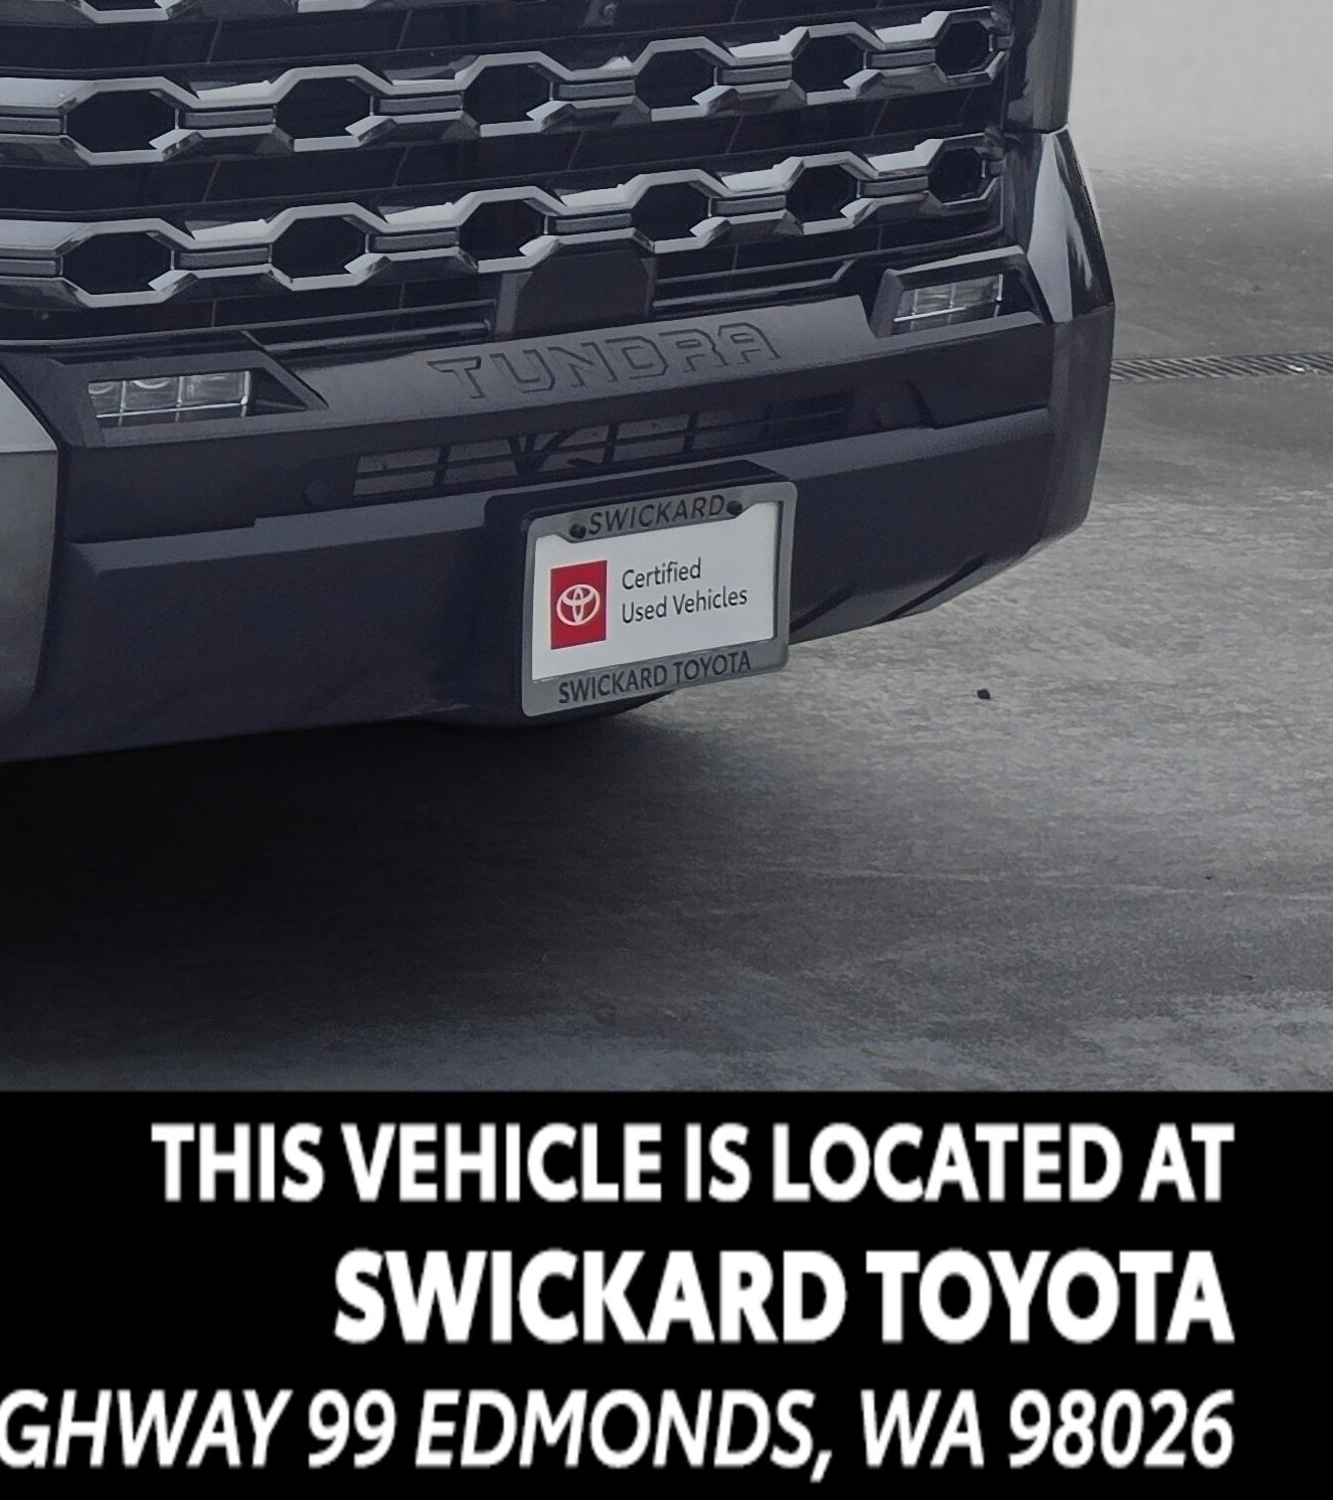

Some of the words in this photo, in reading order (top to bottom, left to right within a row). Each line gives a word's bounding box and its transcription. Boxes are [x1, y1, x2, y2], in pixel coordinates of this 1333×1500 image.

[427, 321, 781, 400] TUNDRA
[588, 494, 726, 535] SWICKARD
[621, 557, 702, 590] Certified
[622, 596, 667, 623] Used
[673, 586, 748, 616] Vehicles
[558, 665, 668, 704] SWICKARD
[673, 650, 751, 684] TOYOTA
